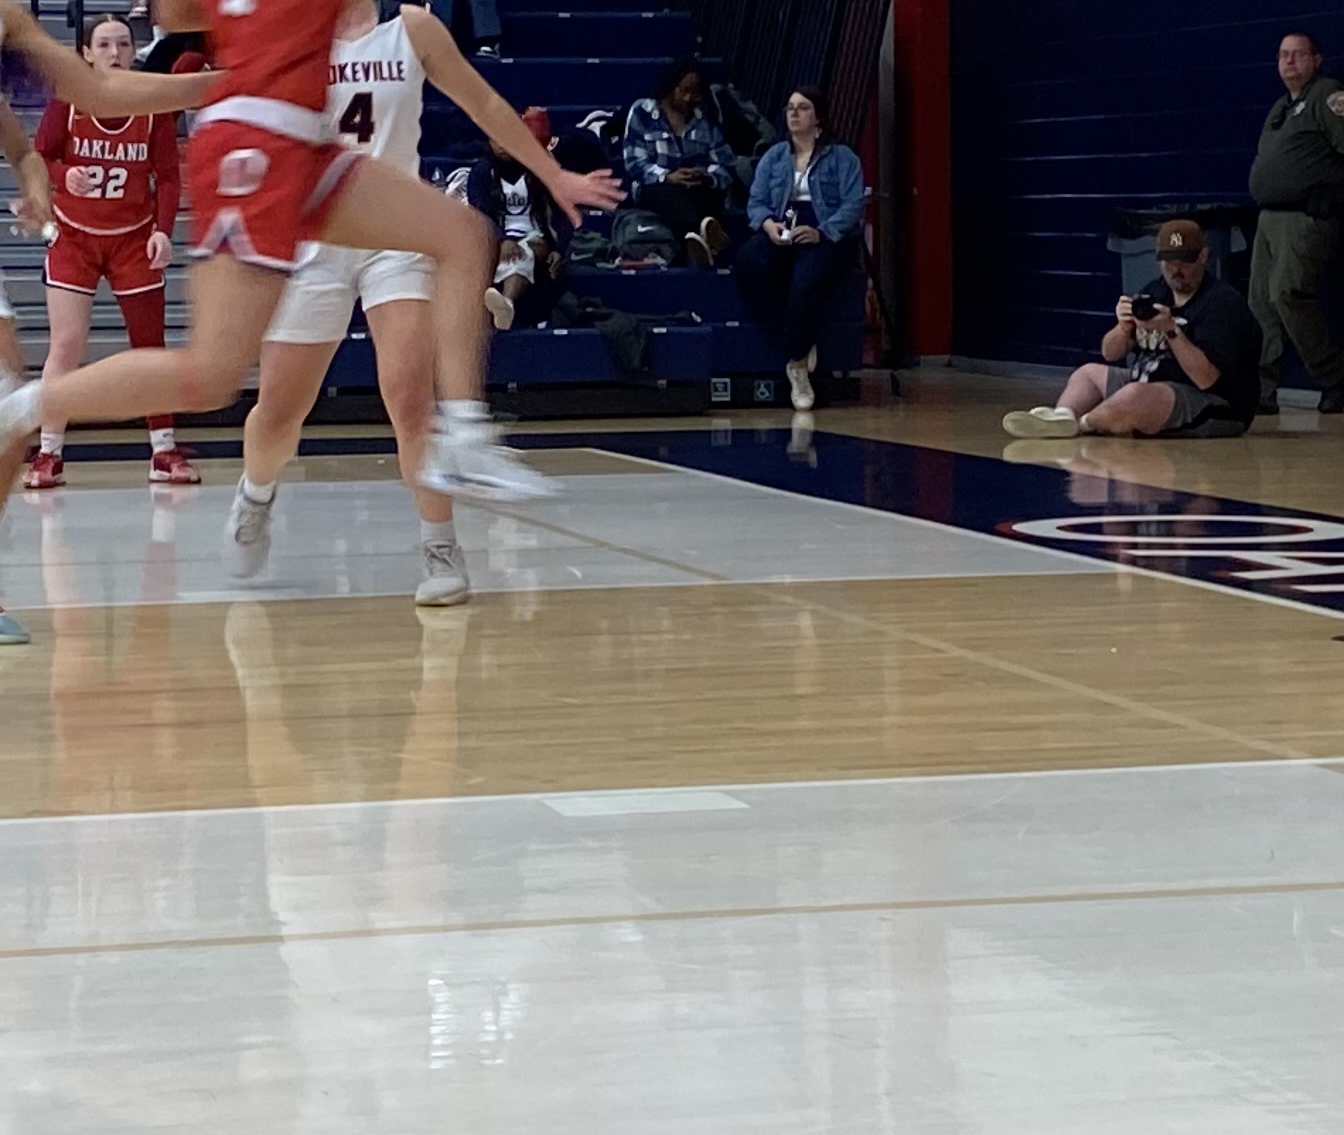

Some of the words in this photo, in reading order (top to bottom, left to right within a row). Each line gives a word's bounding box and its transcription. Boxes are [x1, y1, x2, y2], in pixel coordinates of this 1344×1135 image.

[327, 60, 406, 85] OKEVILLE
[338, 92, 375, 144] 4
[84, 165, 128, 199] 22
